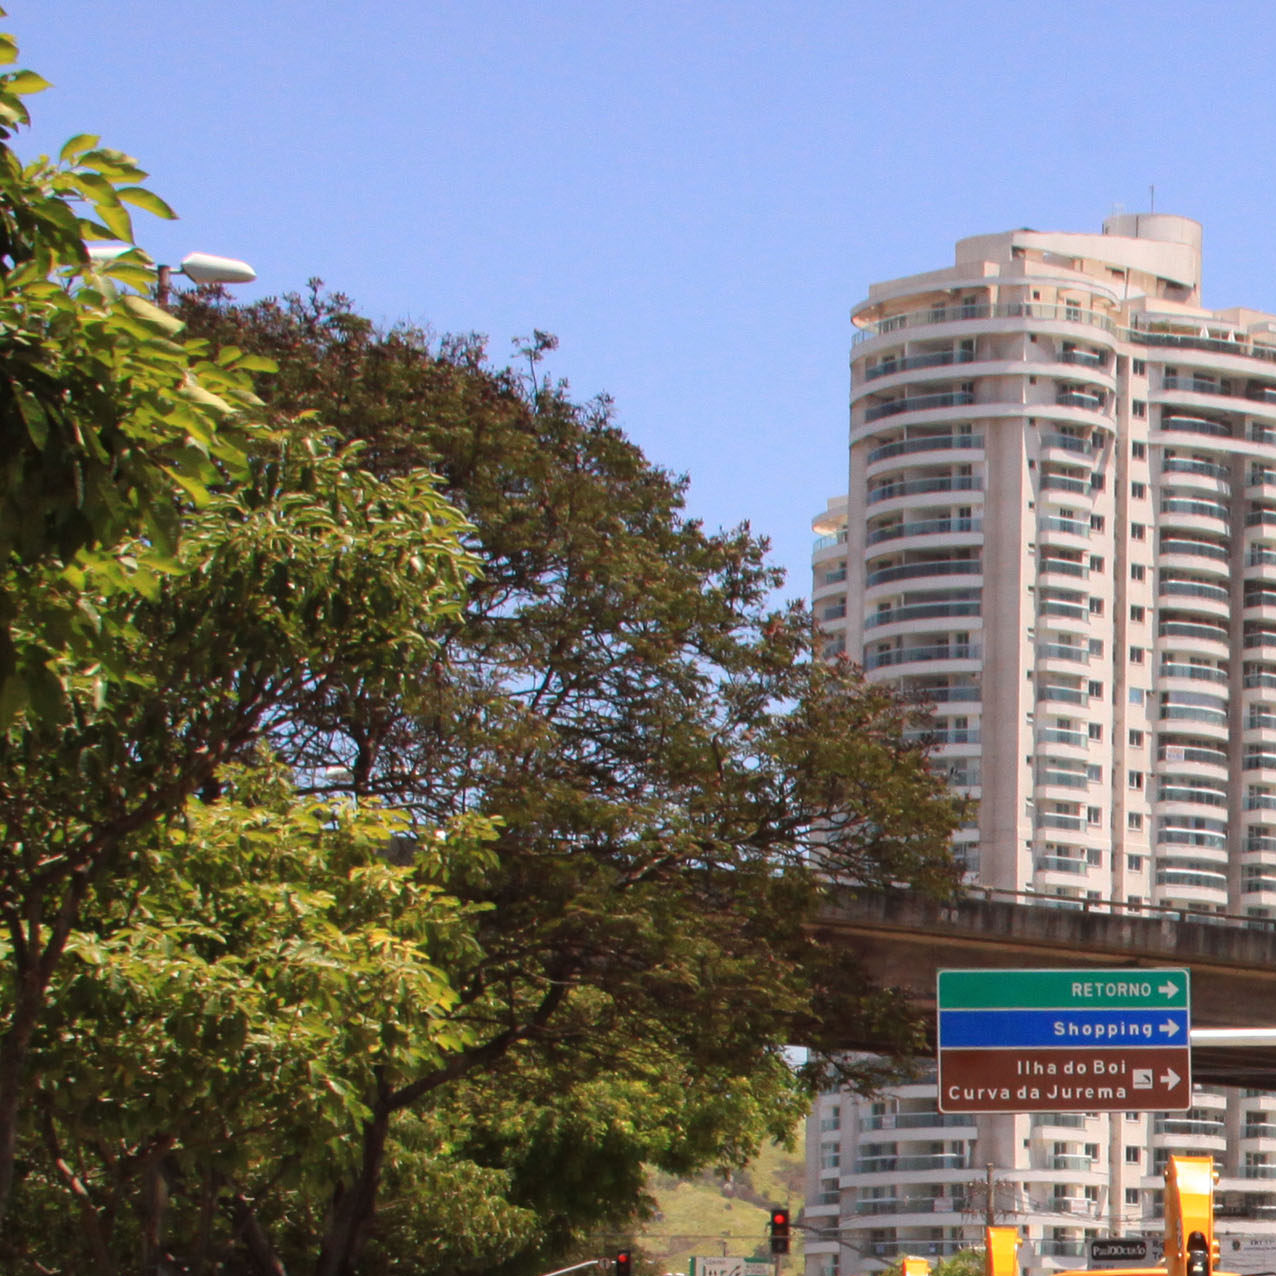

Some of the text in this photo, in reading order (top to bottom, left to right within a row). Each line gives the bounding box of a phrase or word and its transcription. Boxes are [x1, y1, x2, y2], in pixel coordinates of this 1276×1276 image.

[1072, 982, 1151, 998] RETORNO
[1053, 1020, 1152, 1038] Shopping
[1017, 1059, 1126, 1075] Ilha do Boi
[949, 1084, 1127, 1100] Curva da Jurema
